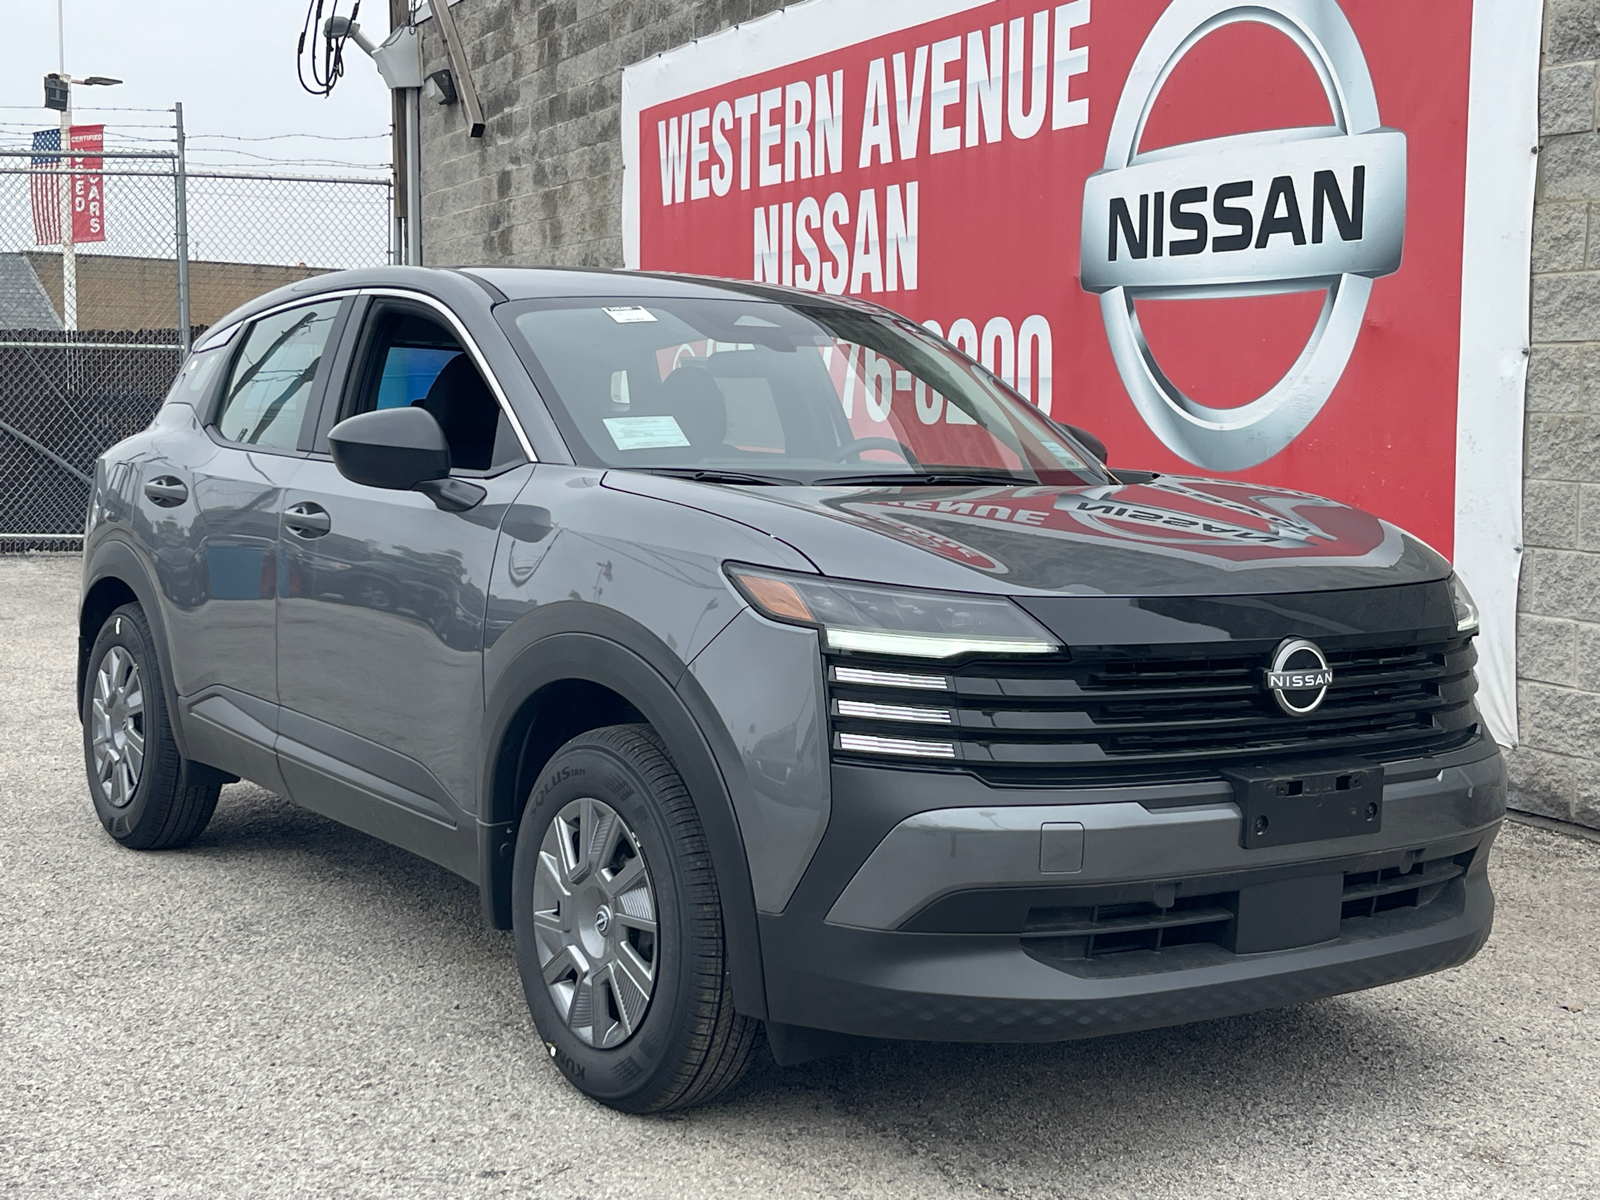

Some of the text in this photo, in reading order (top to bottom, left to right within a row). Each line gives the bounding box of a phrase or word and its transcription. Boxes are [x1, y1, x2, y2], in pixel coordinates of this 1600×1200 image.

[71, 134, 102, 143] CERTIFIED
[658, 0, 1092, 206] WESTERN AVENUE
[753, 181, 919, 295] NISSAN
[1108, 164, 1366, 262] NISSAN
[1270, 671, 1332, 687] NISSAN
